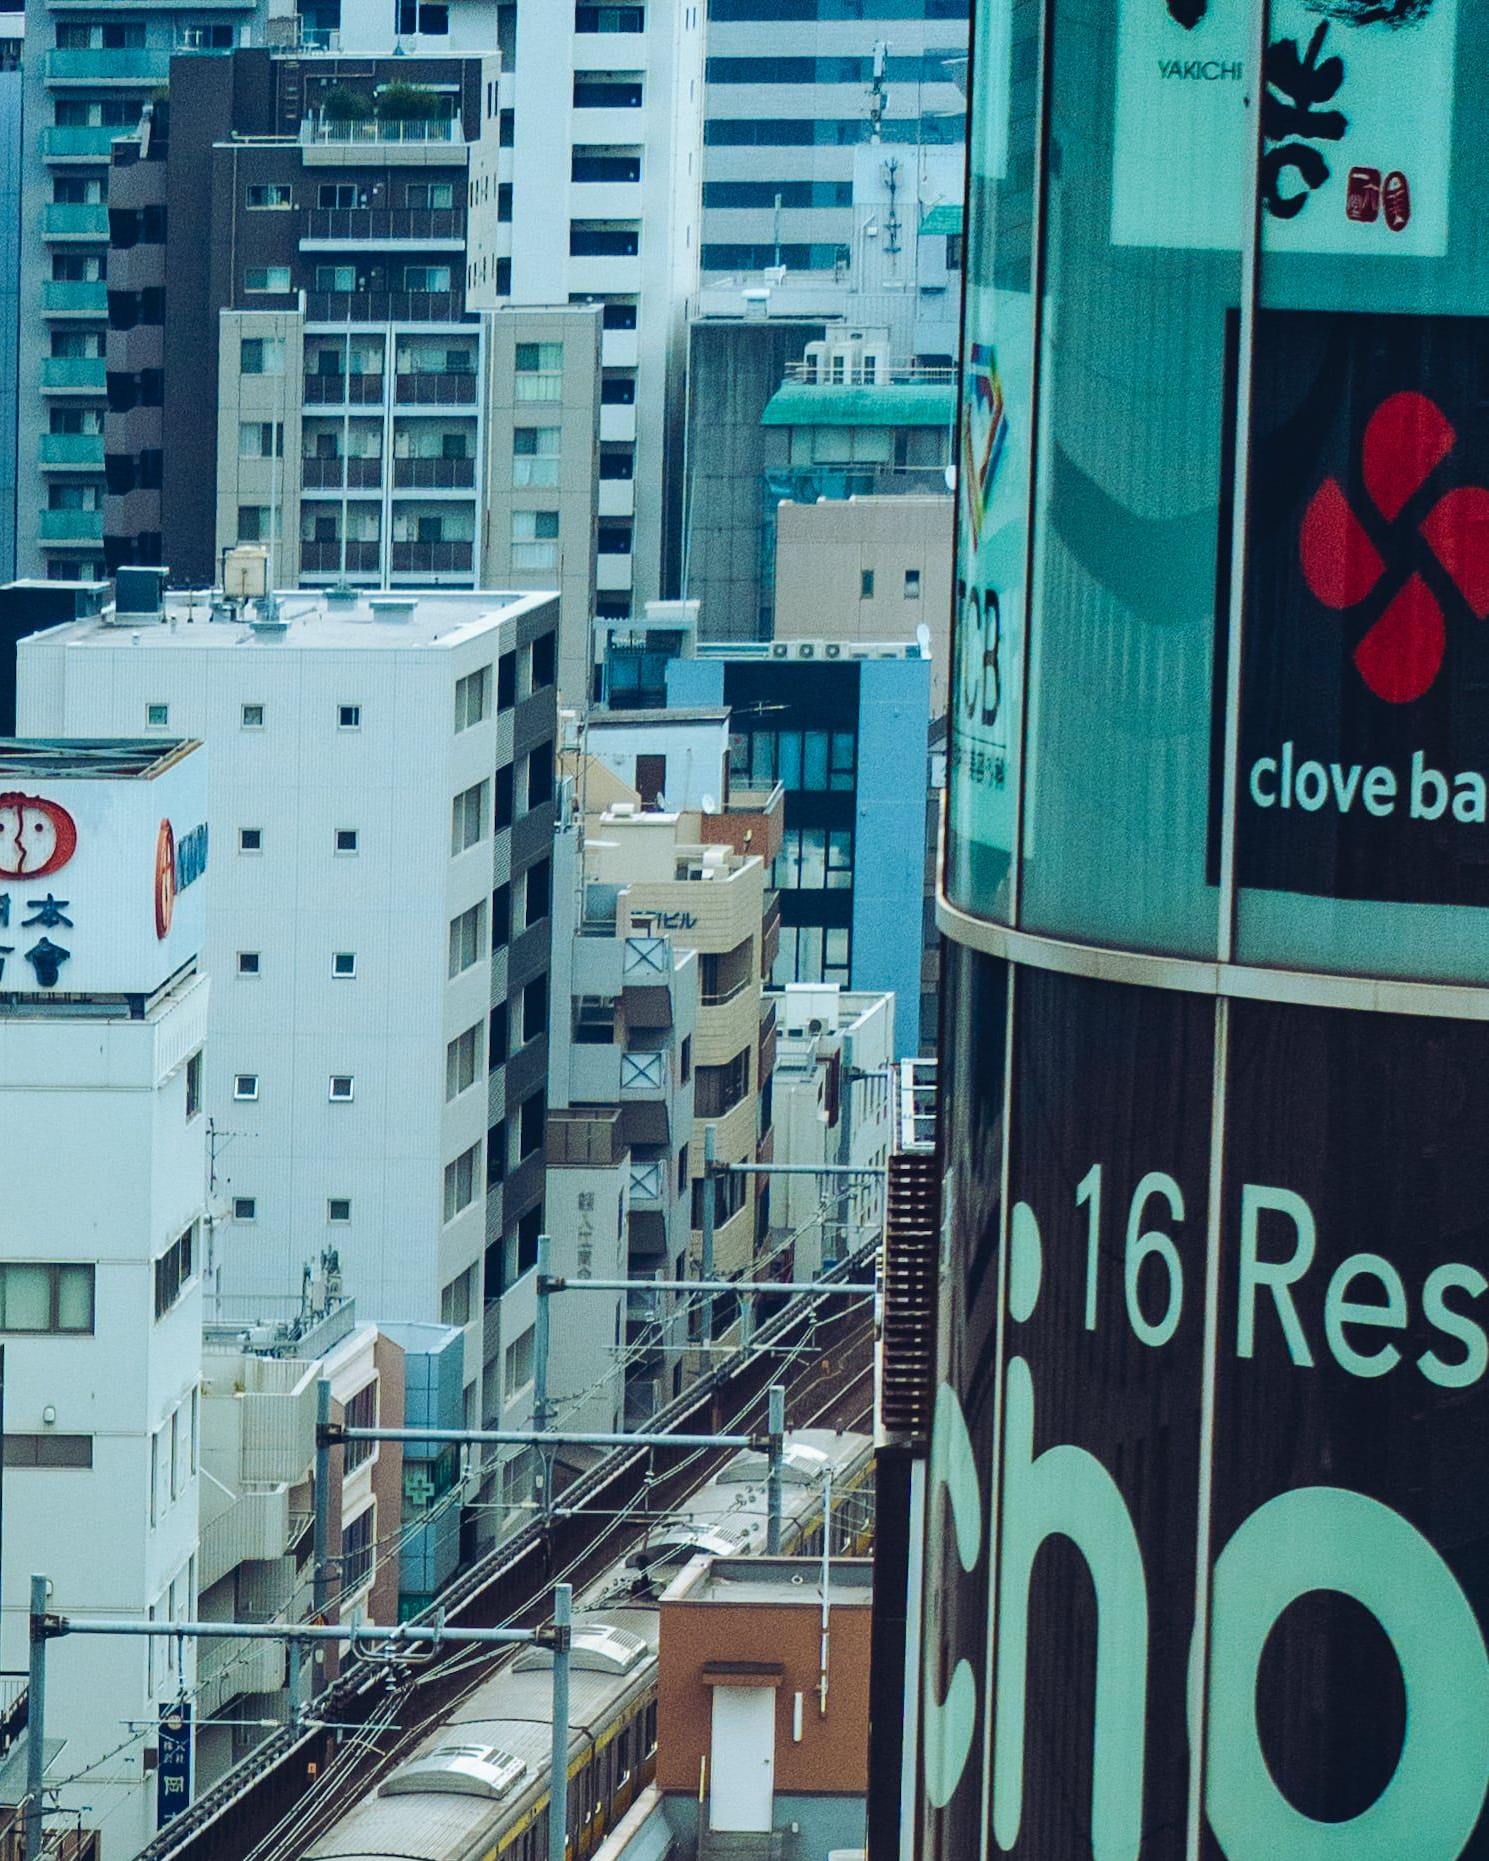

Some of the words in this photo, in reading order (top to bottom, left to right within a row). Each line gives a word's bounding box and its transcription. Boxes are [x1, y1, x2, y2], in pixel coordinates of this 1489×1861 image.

[1157, 60, 1243, 81] YAKICHI
[1249, 740, 1398, 817] clove
[1075, 1162, 1186, 1348] 16
